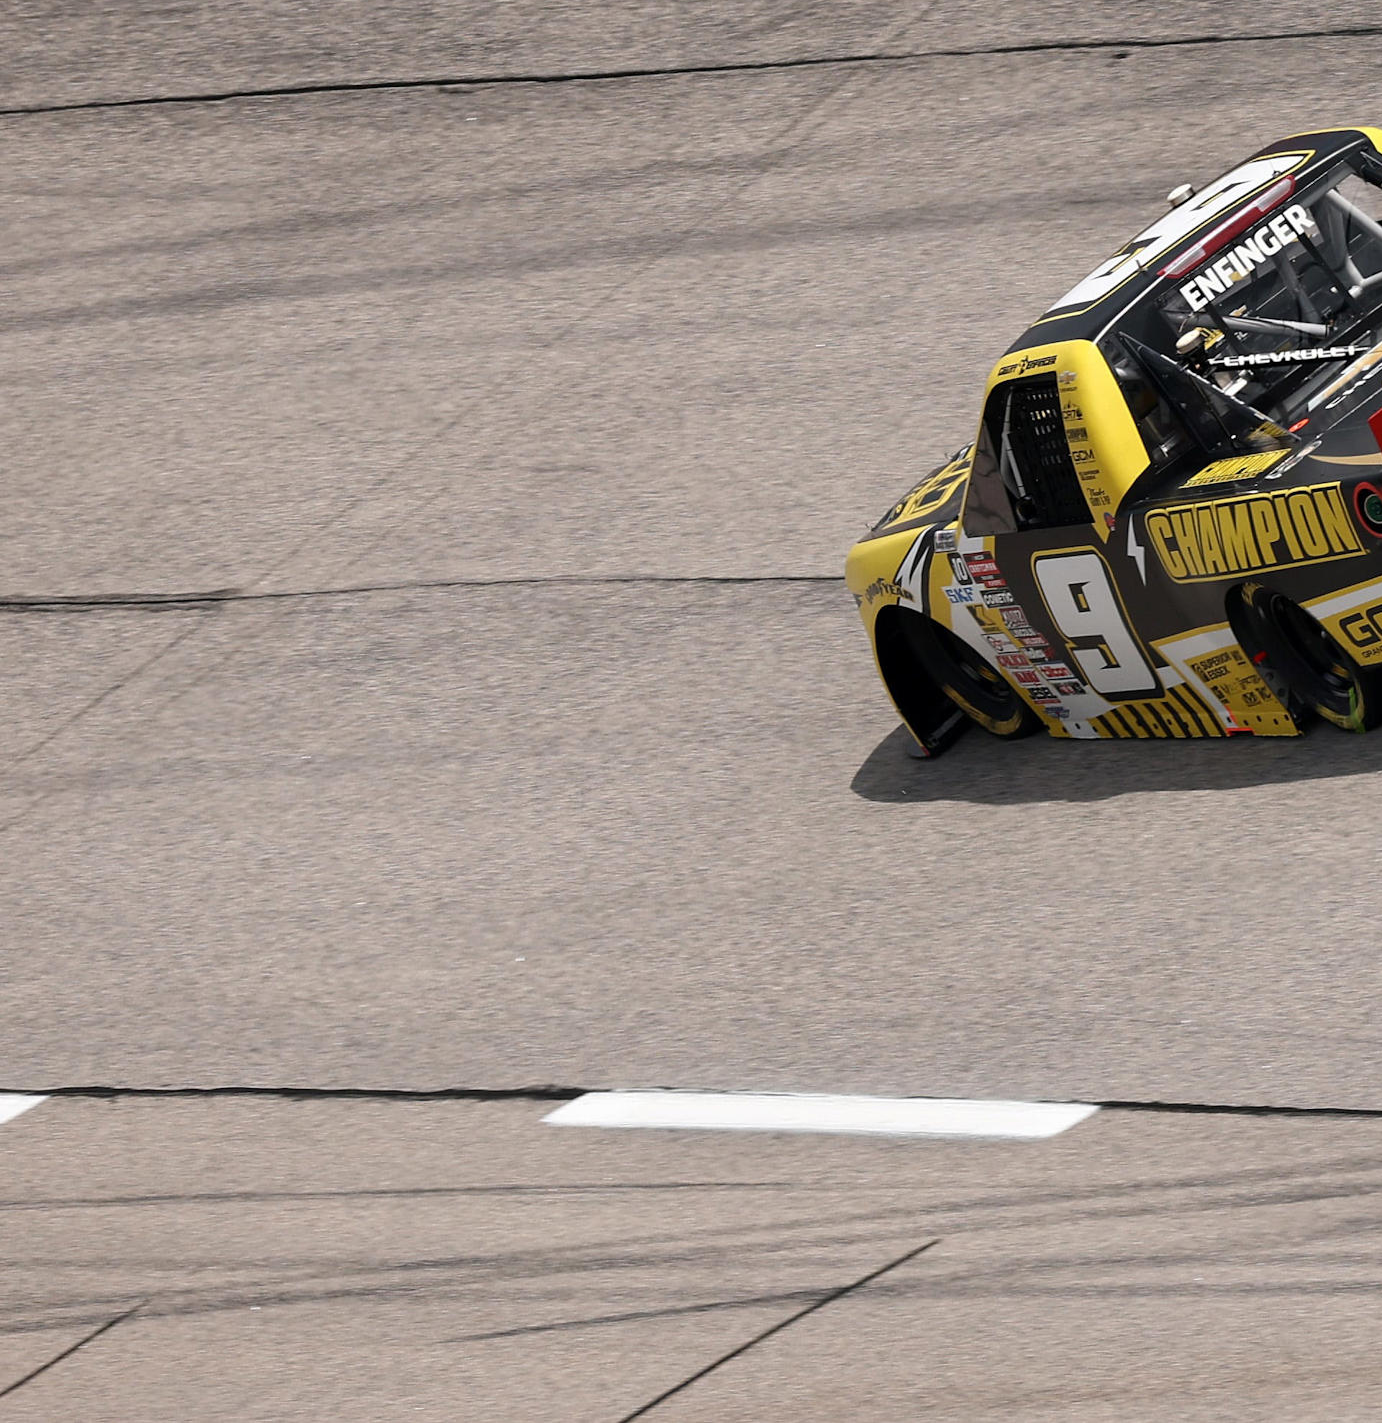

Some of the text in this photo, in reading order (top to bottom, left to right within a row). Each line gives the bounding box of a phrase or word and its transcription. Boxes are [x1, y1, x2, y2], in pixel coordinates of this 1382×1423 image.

[1178, 203, 1316, 313] ENFINGER
[1071, 449, 1097, 463] GCM
[1146, 485, 1364, 581] CHAMPION
[945, 586, 974, 604] SKF
[951, 557, 969, 581] 10
[1034, 553, 1157, 694] 9
